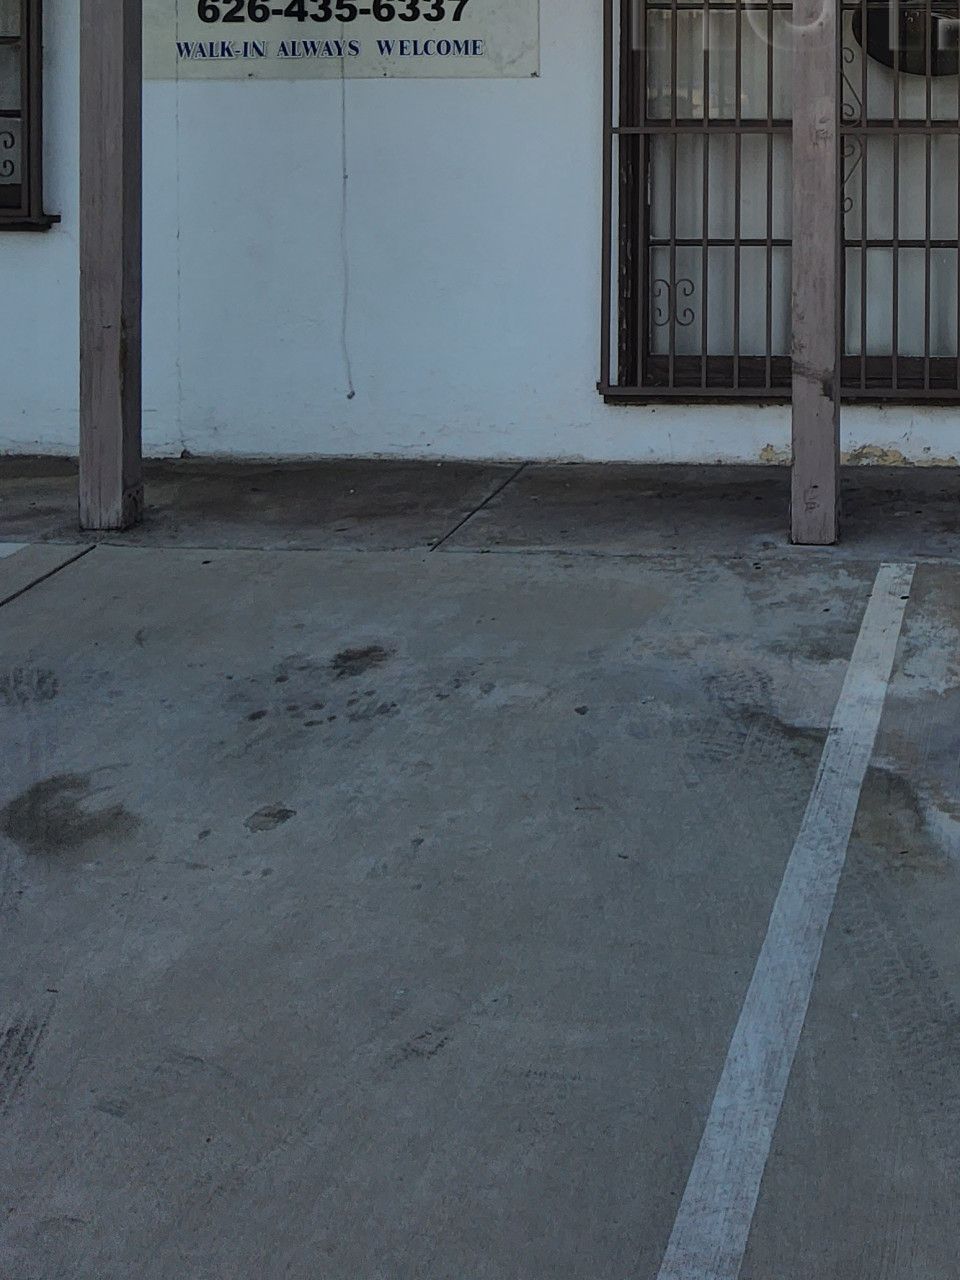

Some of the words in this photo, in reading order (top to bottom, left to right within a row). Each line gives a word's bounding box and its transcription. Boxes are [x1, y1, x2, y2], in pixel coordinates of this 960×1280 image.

[176, 41, 266, 58] WALK-IN
[277, 40, 361, 57] ALWAYS
[377, 39, 484, 57] WELCOME
